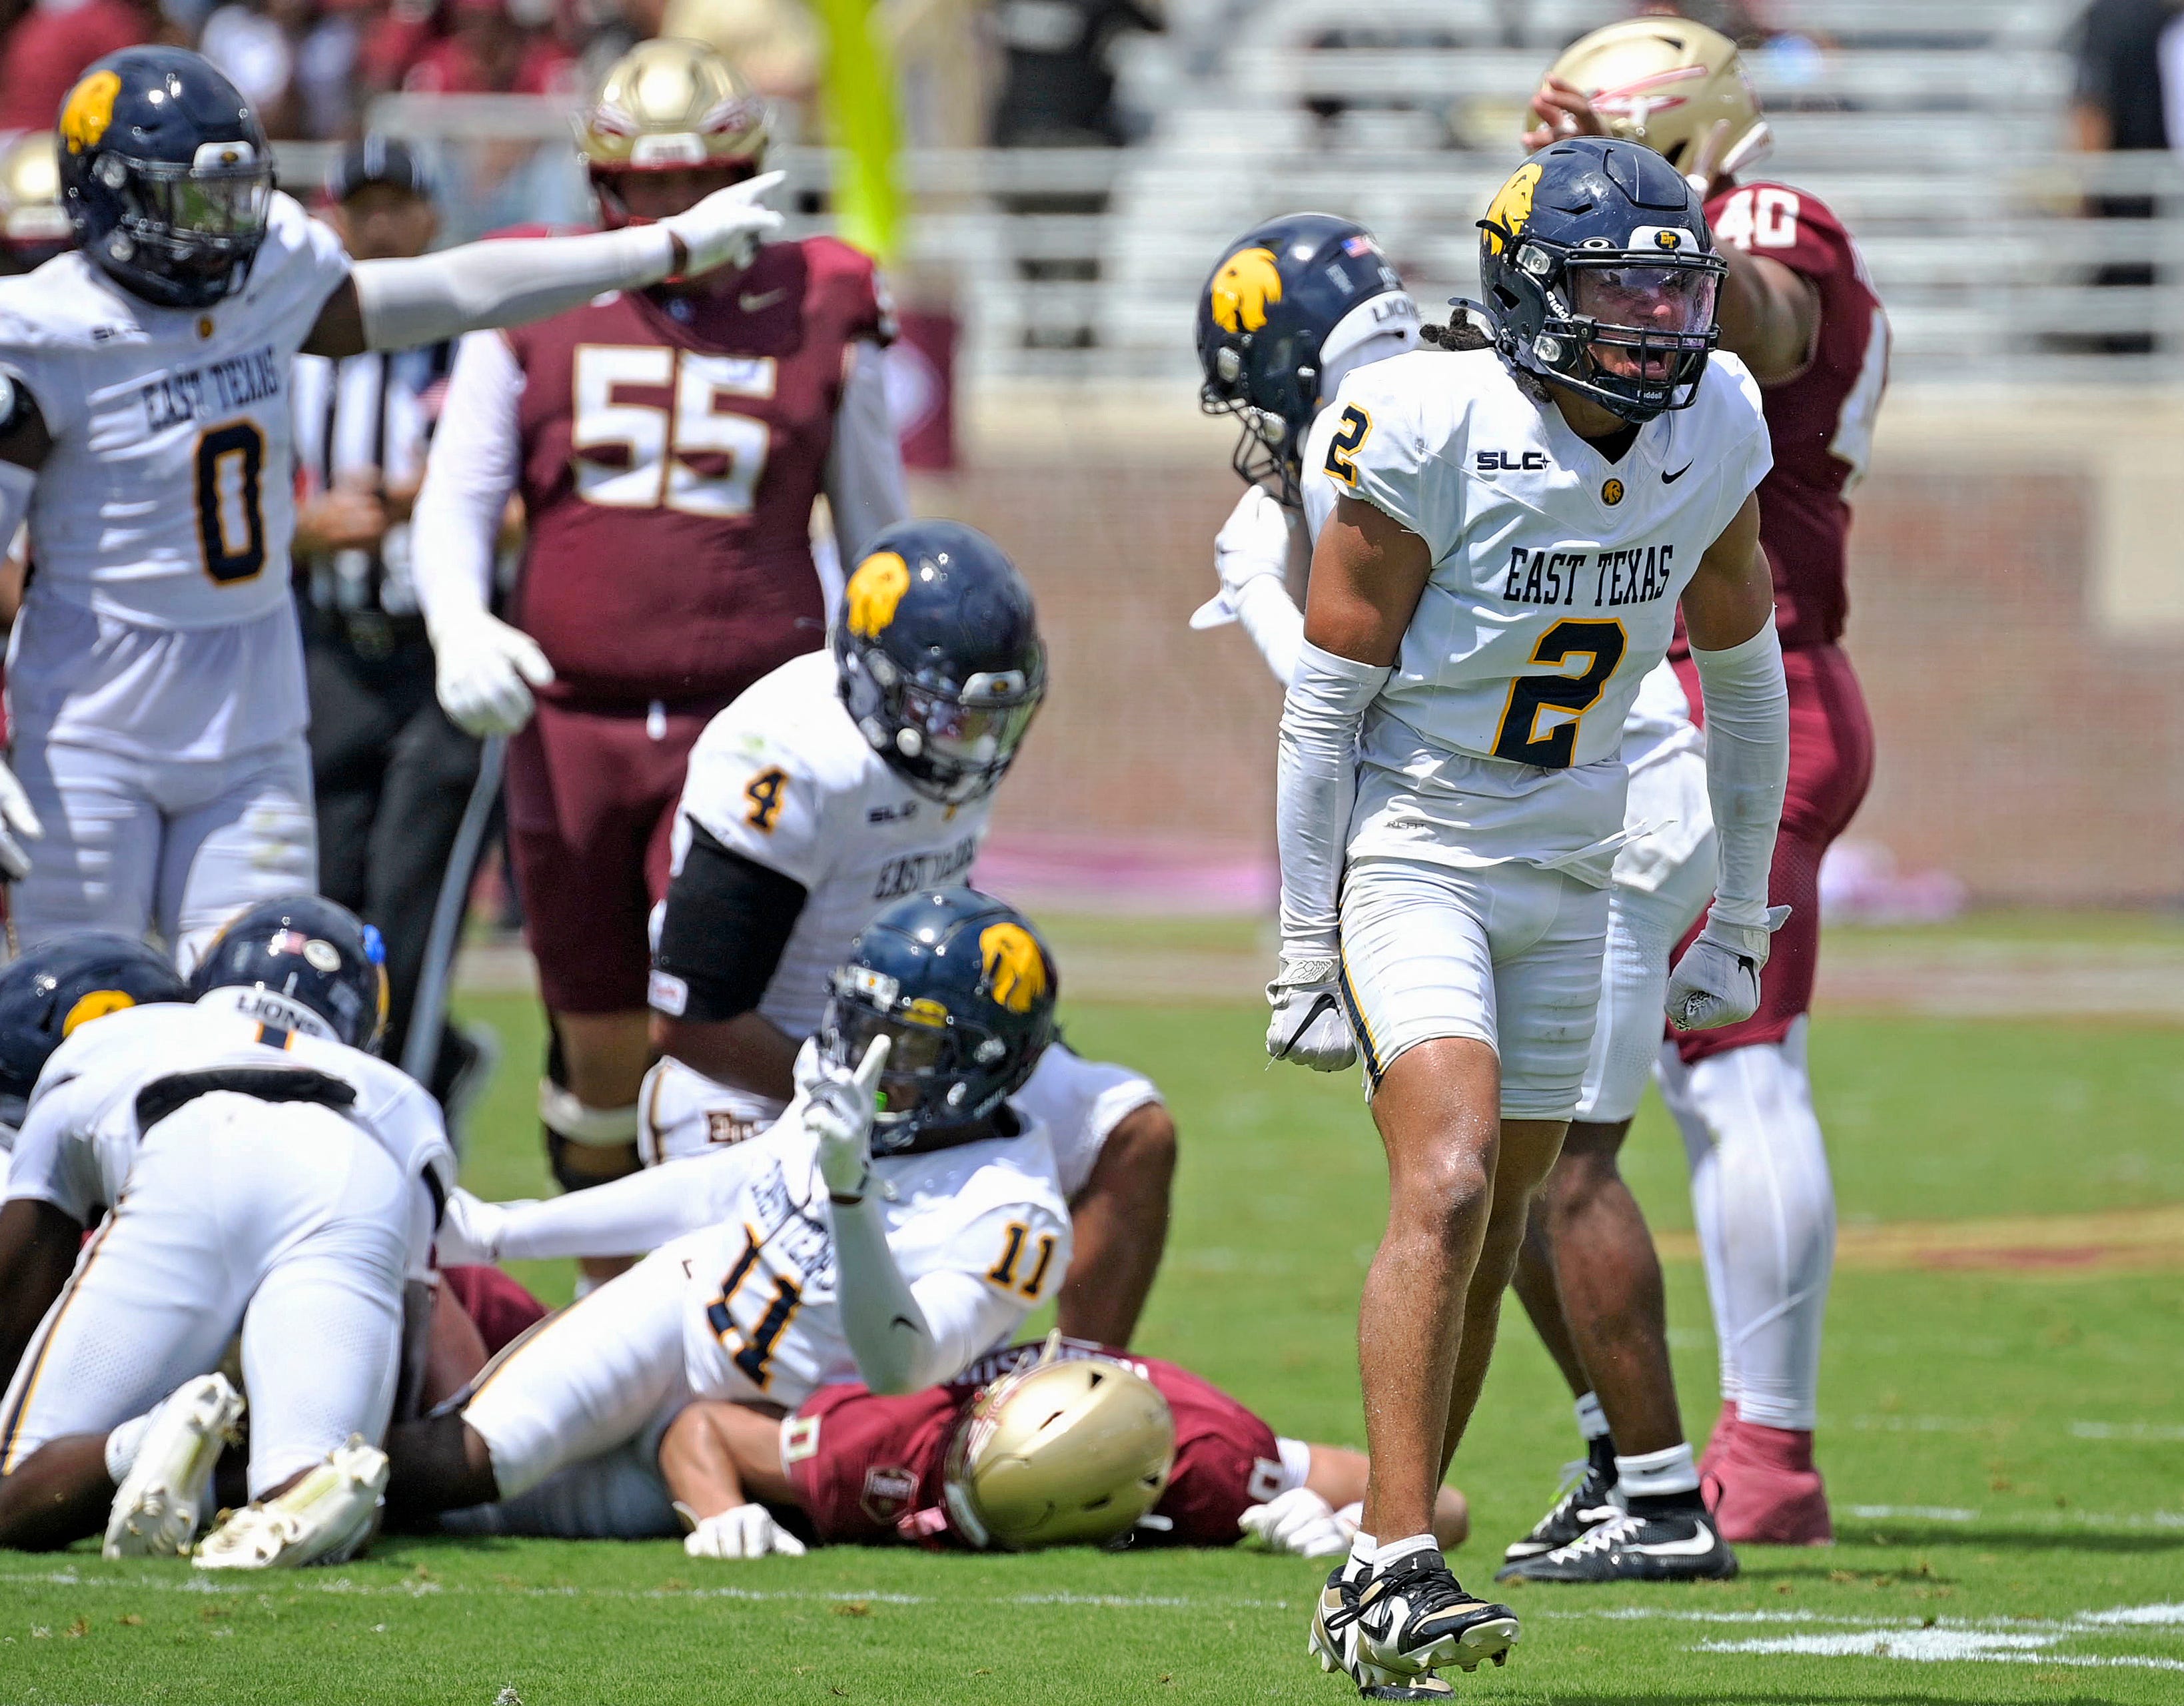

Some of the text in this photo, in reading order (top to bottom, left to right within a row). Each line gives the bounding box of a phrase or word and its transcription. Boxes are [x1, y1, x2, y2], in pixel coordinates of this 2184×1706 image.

[1713, 187, 1799, 250] 40
[571, 342, 778, 520] 55
[1323, 401, 1373, 488] 2
[193, 416, 269, 590] 0
[1503, 544, 1674, 608] EAST TEXAS
[1488, 617, 1629, 769] 2
[744, 772, 788, 834] 4
[986, 1220, 1058, 1302] 11
